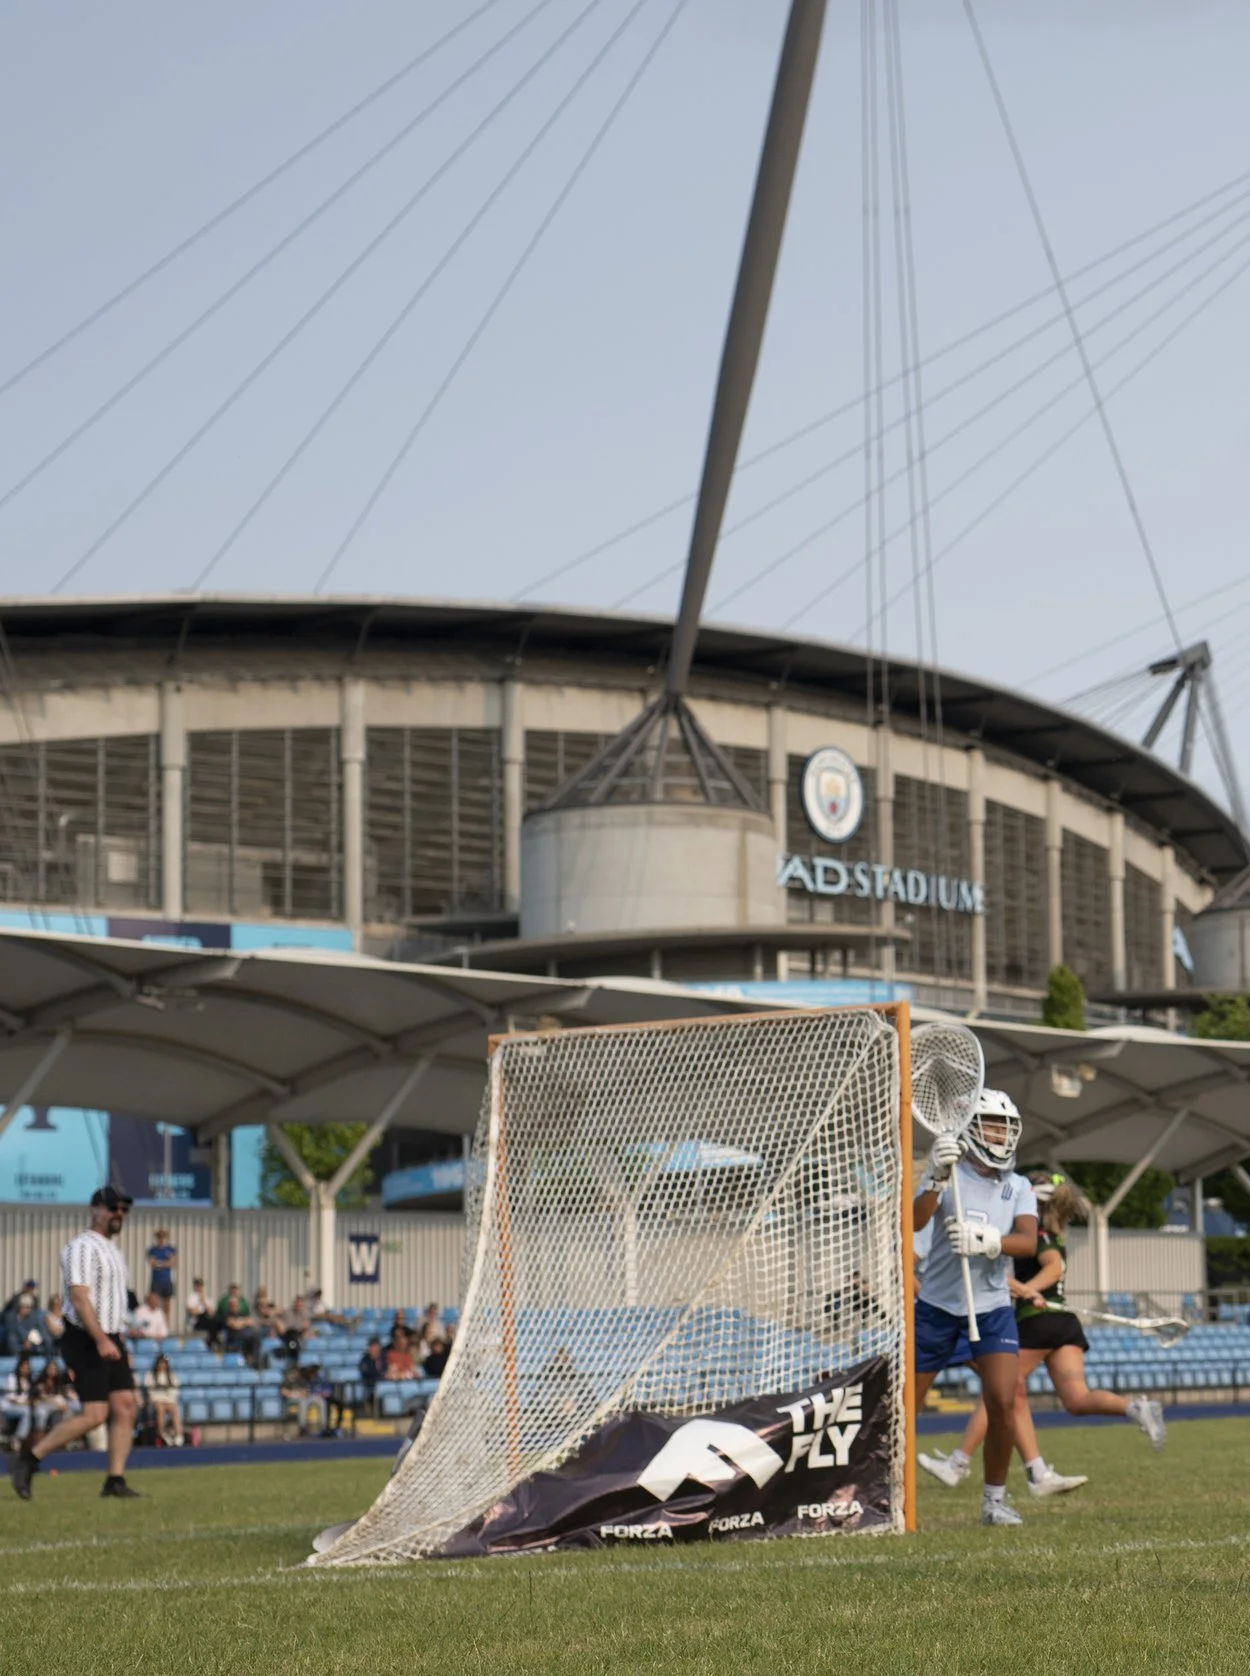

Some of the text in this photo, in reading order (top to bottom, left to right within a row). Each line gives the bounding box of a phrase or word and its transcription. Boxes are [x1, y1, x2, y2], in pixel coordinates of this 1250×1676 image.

[777, 855, 984, 914] AD STADIUM
[349, 1241, 378, 1275] W
[776, 1382, 864, 1433] THE
[784, 1423, 862, 1473] FLY
[709, 1511, 764, 1533] FORZA
[798, 1500, 864, 1519] FORZA
[601, 1523, 673, 1539] FORZA
